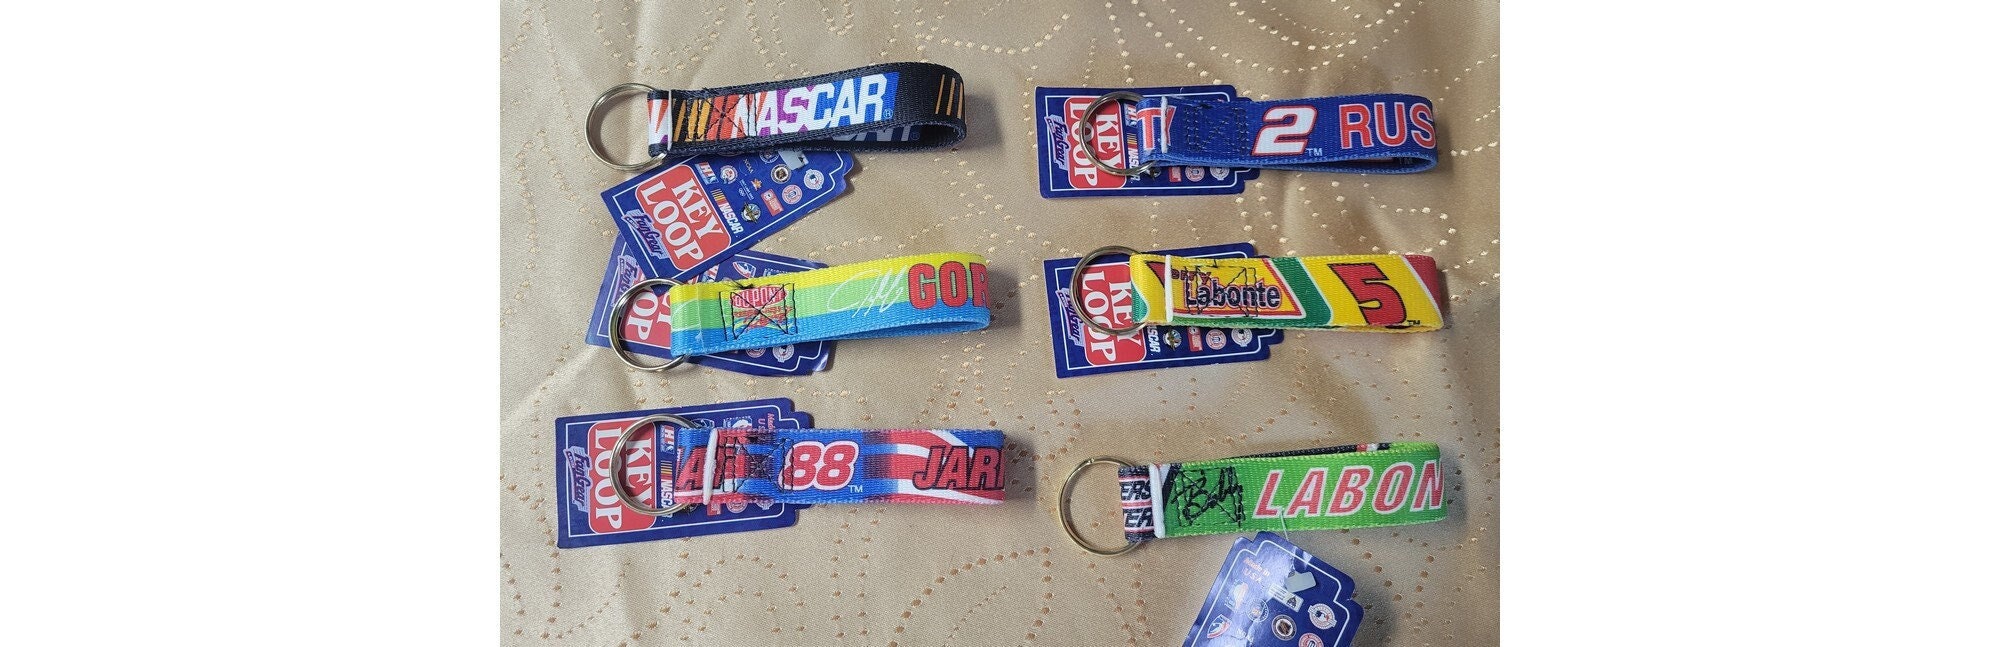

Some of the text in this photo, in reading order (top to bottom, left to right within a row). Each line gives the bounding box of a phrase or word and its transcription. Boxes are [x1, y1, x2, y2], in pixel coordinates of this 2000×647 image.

[730, 73, 888, 141] NASCAR
[1250, 104, 1319, 157] 2
[1338, 101, 1436, 150] RUS
[1053, 119, 1069, 166] FanGear
[634, 213, 664, 256] FanGear
[640, 180, 704, 260] LOOP
[671, 177, 724, 240] KEY
[718, 203, 744, 235] NASCAR
[908, 261, 990, 310] GOR
[1184, 277, 1282, 309] Labonte
[1327, 262, 1407, 326] 5
[572, 453, 592, 508] FanGear
[594, 427, 623, 530] LOOP
[777, 440, 863, 493] 88 TM
[912, 445, 1005, 491] JAR
[1252, 459, 1445, 519] LABON
